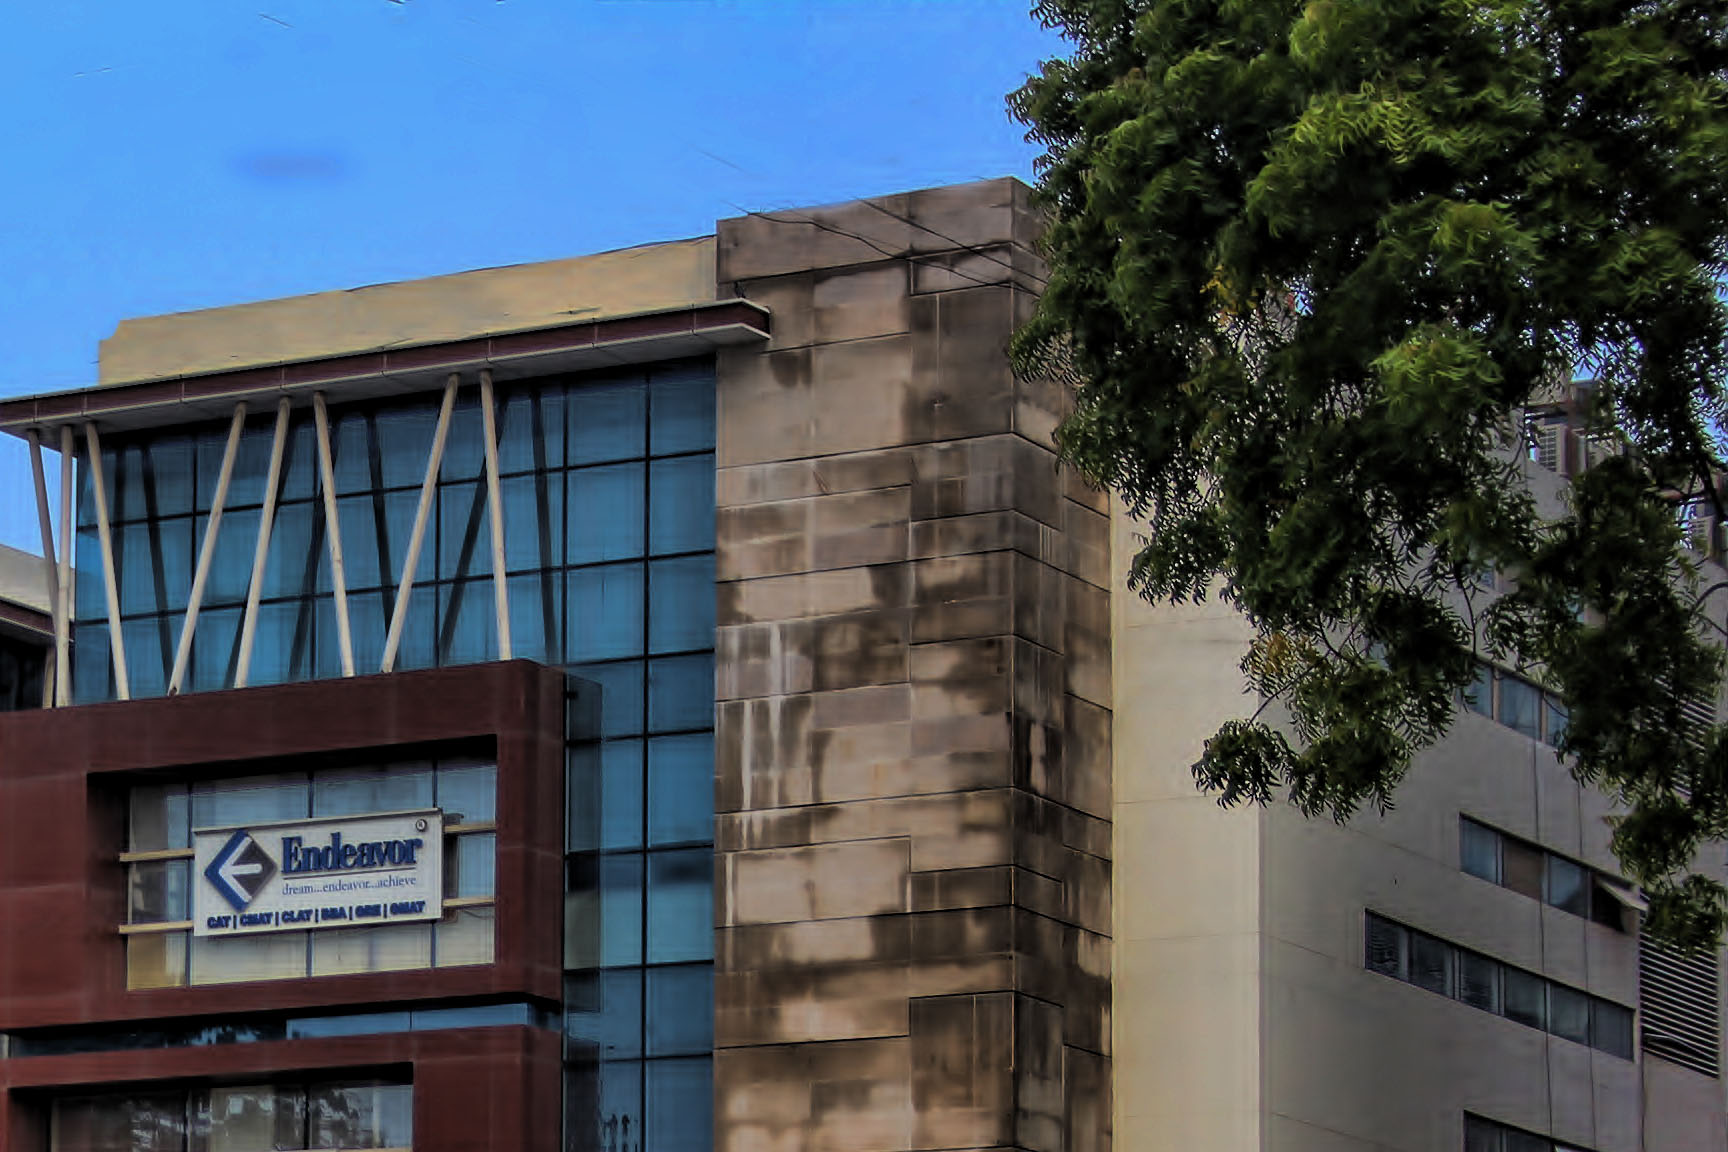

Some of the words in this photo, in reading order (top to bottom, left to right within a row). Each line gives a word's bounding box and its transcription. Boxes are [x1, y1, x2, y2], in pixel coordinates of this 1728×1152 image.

[282, 832, 423, 874] Endeavor
[207, 914, 231, 928] CAT
[282, 908, 313, 923] CLAT
